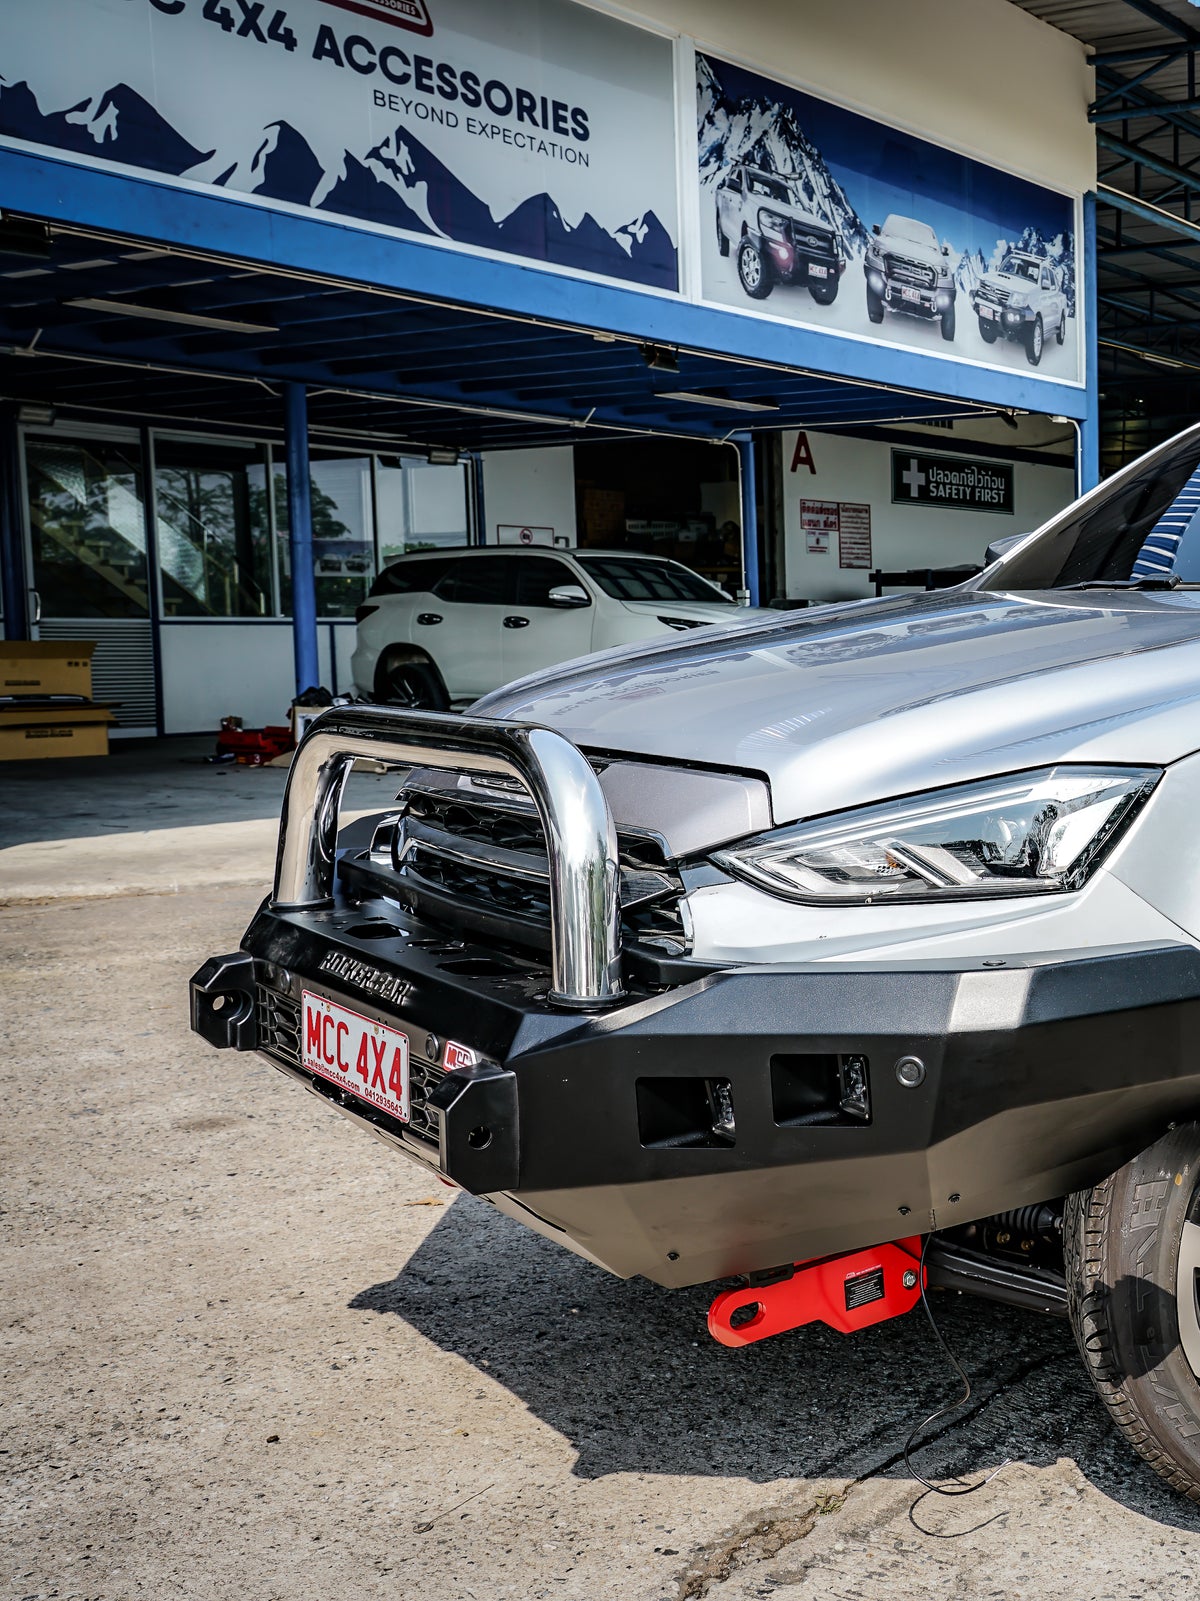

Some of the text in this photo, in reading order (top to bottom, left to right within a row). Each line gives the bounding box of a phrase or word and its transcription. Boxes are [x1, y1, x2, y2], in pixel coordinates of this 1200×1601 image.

[202, 0, 591, 142] 4X4 ACCESSORIES
[373, 89, 590, 168] BEYOND EXPECTATION
[790, 431, 817, 475] A
[929, 466, 1005, 490] ปลอดภัยไว้ก่อน
[929, 483, 1005, 504] SAFETY FIRST
[318, 950, 380, 995] ROCKER
[307, 1005, 403, 1102] MCC 4X4
[307, 1058, 403, 1116] sales@mcc4x4.com 0412935643
